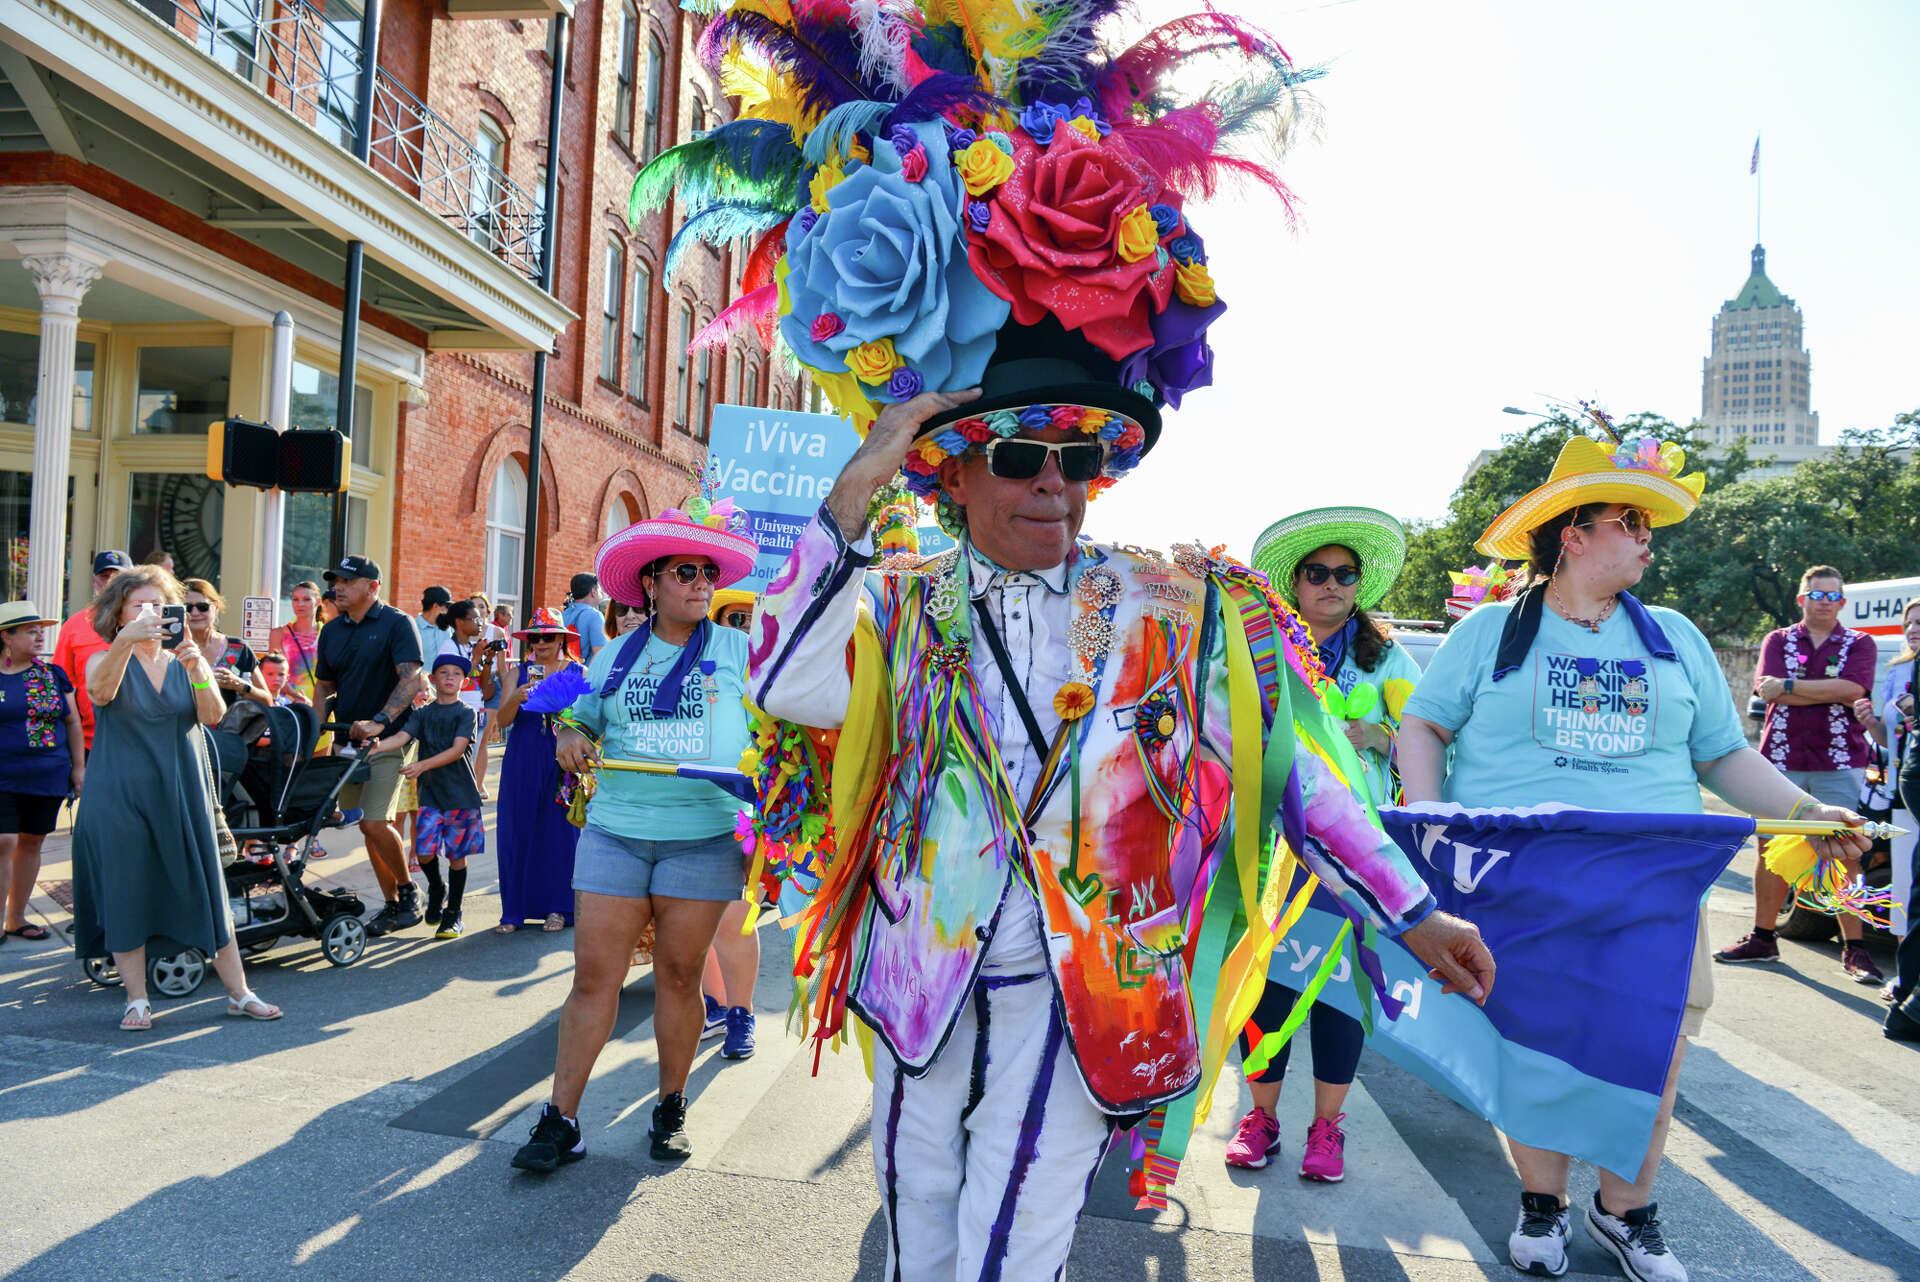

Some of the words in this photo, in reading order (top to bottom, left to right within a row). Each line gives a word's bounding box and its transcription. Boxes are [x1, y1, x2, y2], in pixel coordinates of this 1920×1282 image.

[744, 419, 827, 458] ¡Viva
[753, 517, 808, 536] Universi
[752, 532, 795, 550] Health
[627, 721, 705, 738] THINKING
[1543, 707, 1648, 735] THINKING
[635, 737, 704, 754] BEYOND
[1555, 728, 1646, 753] BEYOND
[1571, 763, 1599, 773] Health
[1600, 765, 1629, 775] System
